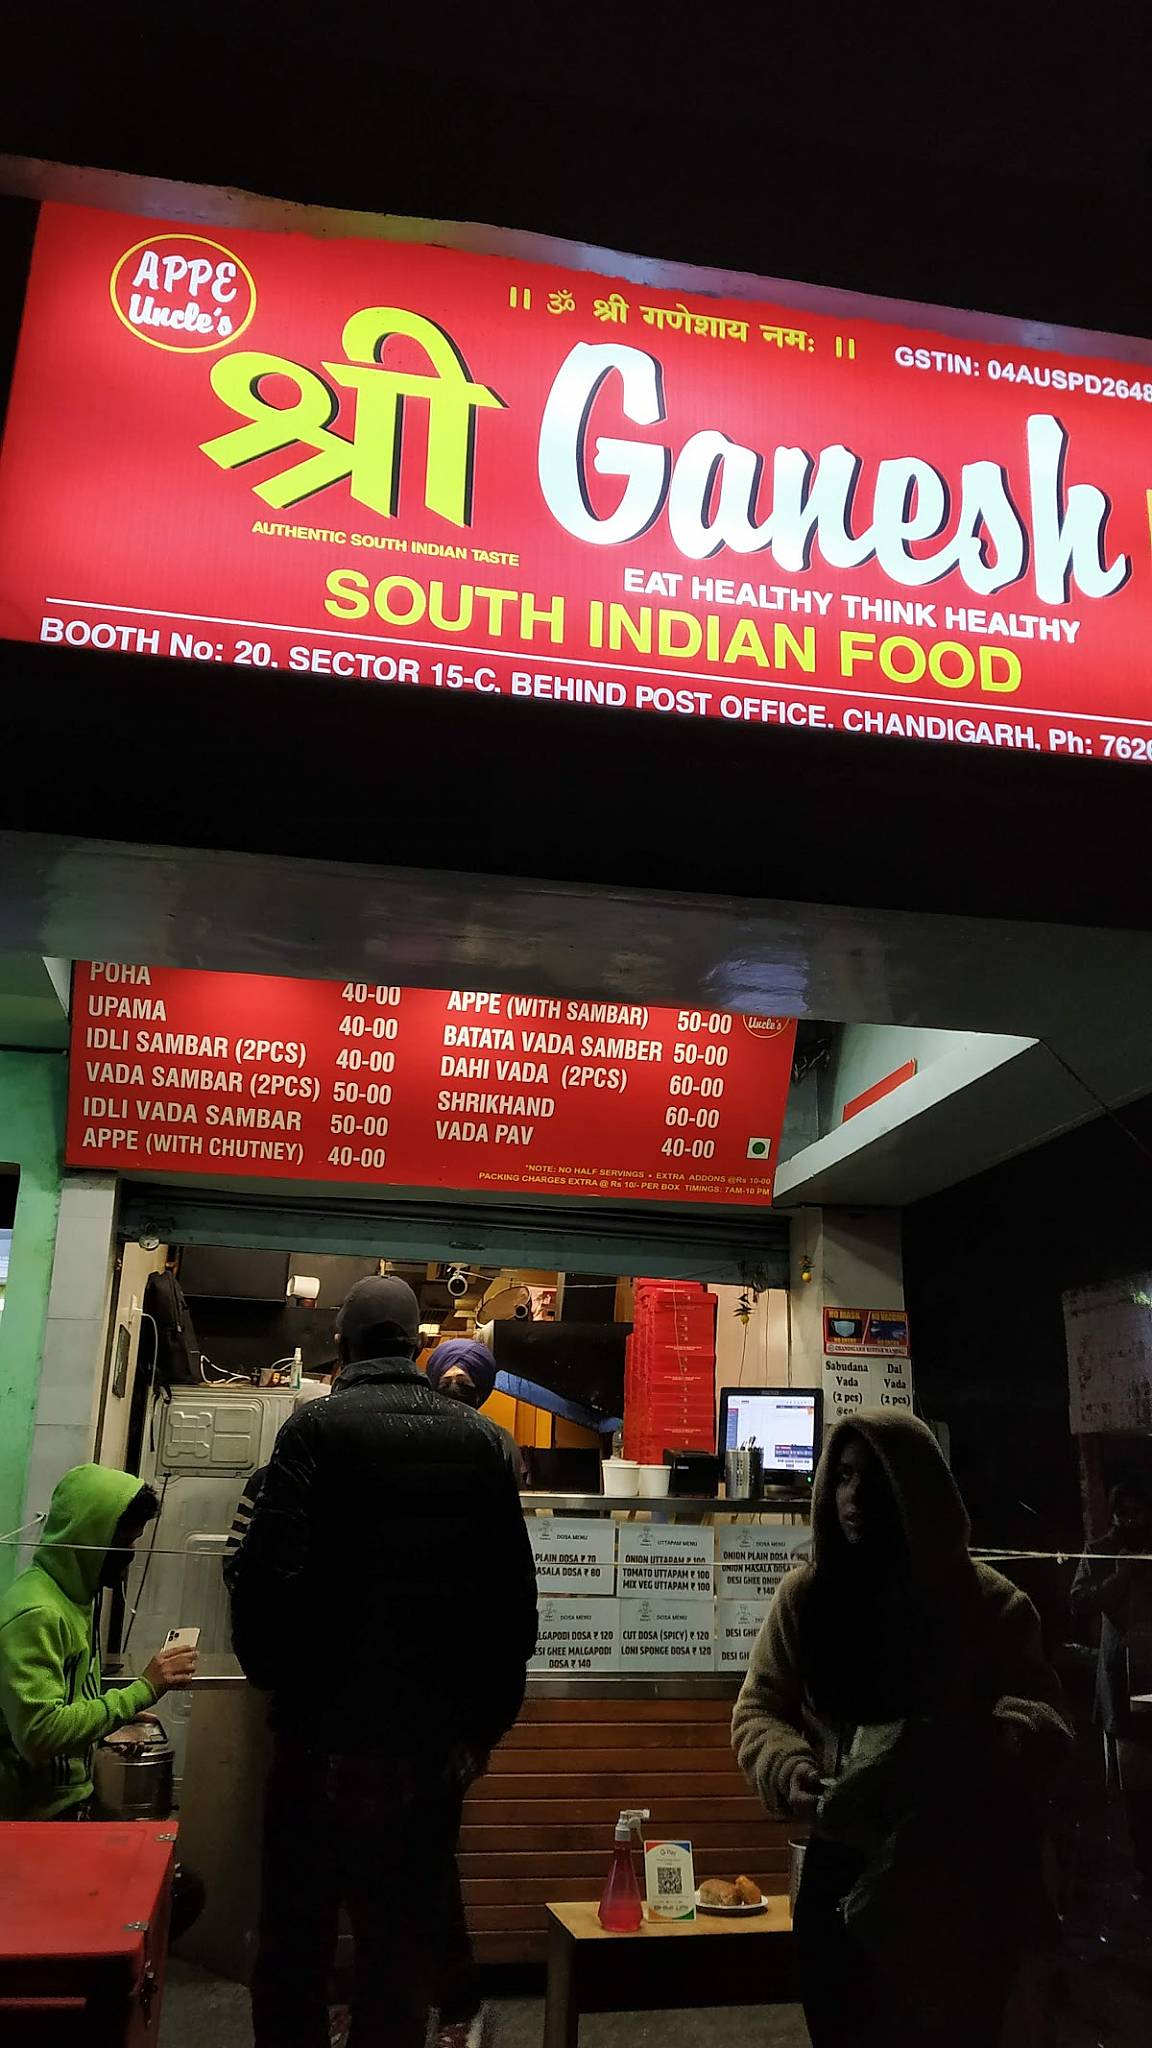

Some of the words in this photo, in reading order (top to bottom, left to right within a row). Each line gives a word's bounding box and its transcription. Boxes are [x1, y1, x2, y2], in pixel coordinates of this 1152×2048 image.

[132, 251, 237, 302] APPE
[128, 293, 233, 337] Uncle's
[593, 293, 629, 324] श्री
[639, 303, 749, 342] गणेशाय
[759, 324, 815, 353] नमः
[895, 346, 980, 377] GSTIN:
[198, 306, 510, 528] श्री
[538, 341, 1132, 604] Ganesh
[252, 521, 347, 545] AUTHENTIC
[350, 533, 408, 553] SOUTH
[411, 541, 467, 560] INDIAN
[471, 548, 519, 566] TASTE
[623, 567, 682, 596] EAT
[692, 577, 833, 617] HEALTHY
[841, 594, 936, 628] THINK
[945, 606, 1080, 644] HEALTHY
[324, 568, 564, 644] SOUTH
[589, 600, 815, 673] INDIAN
[840, 631, 1022, 693] FOOD
[40, 616, 159, 655] BOOTH
[169, 635, 224, 663] No:
[288, 645, 420, 684] SECTOR
[511, 671, 626, 707] BEHIND
[635, 684, 712, 716] POST
[1048, 728, 1093, 755] Ph:
[90, 961, 151, 985] POHA
[342, 982, 400, 1006] 40-00
[87, 995, 166, 1021] UPAMA
[447, 991, 501, 1014] APPE
[506, 995, 561, 1020] (WITH
[566, 1001, 649, 1030] SAMBAR)
[339, 1015, 398, 1040] 40-00
[677, 1011, 732, 1035] 50-00
[748, 1016, 782, 1030] Uncle's
[86, 1027, 128, 1051] IDLI
[135, 1030, 228, 1059] SAMBAR
[235, 1038, 306, 1068] (2PCS)
[443, 1025, 515, 1051] BATATA
[521, 1031, 575, 1056] VADA
[580, 1036, 663, 1062] SAMBER
[673, 1043, 729, 1067] 50-00
[336, 1048, 394, 1073] 40-00
[86, 1062, 144, 1085] VADA
[151, 1066, 242, 1094] SAMBAR
[250, 1073, 320, 1102] (2PCS)
[440, 1056, 489, 1079] DAHI
[496, 1060, 549, 1084] VADA
[561, 1064, 628, 1093] (2PCS)
[333, 1081, 391, 1105] 50-00
[669, 1075, 724, 1098] 60-00
[83, 1097, 128, 1119] IDLI
[136, 1101, 198, 1124] VADA
[205, 1105, 302, 1132] SAMBAR
[437, 1091, 555, 1118] SHRIKHAND
[330, 1114, 388, 1137] 50-00
[665, 1106, 720, 1129] 60-00
[435, 1120, 489, 1143] VADA
[495, 1124, 534, 1146] PAV
[82, 1127, 138, 1150] APPE
[146, 1132, 203, 1156] (WITH
[209, 1137, 304, 1165] CHUTNEY)
[328, 1146, 385, 1168] 40-00
[661, 1138, 715, 1160] 40-00
[479, 1172, 520, 1181] PACKING
[521, 1175, 566, 1184] CHARGES
[568, 1178, 598, 1186] EXTRA
[599, 1180, 609, 1188] @
[611, 1180, 622, 1188] Rs
[641, 1182, 659, 1190] PER
[661, 1183, 680, 1191] BOX
[685, 1184, 722, 1193] TIMINGS:
[558, 1166, 572, 1174] NO
[599, 1169, 644, 1178] SERVINGS
[656, 1172, 685, 1180] EXTRA
[688, 1174, 726, 1183] ADDONS
[825, 1361, 869, 1373] Sabudana
[887, 1364, 902, 1374] Dal
[836, 1376, 859, 1387] Vada
[884, 1379, 906, 1389] Vada
[833, 1391, 842, 1404] (2
[844, 1392, 862, 1405] pcs)
[880, 1393, 890, 1406] (2
[892, 1394, 911, 1407] pcs)
[535, 1553, 557, 1562] PLAIN
[560, 1554, 578, 1562] DOSA
[625, 1555, 648, 1563] ONION
[723, 1551, 746, 1560] ONION
[747, 1552, 768, 1560] PLAIN
[536, 1567, 560, 1576] ASALA
[562, 1568, 582, 1576] DOSA
[623, 1568, 653, 1577] TOMATO
[654, 1569, 689, 1578] UTTAPAM
[697, 1570, 710, 1579] 100
[744, 1564, 772, 1573] MASALA
[623, 1579, 637, 1589] MIX
[639, 1580, 653, 1589] VEG
[654, 1581, 689, 1590] UTTAPAM
[697, 1582, 711, 1591] 100
[727, 1576, 742, 1584] DESI
[743, 1576, 760, 1585] GHEE
[572, 1631, 591, 1640] DOSA
[600, 1631, 613, 1640] 120
[622, 1631, 636, 1640] CUT
[638, 1631, 658, 1640] DOSA
[660, 1630, 688, 1642] (SPICY)
[696, 1631, 709, 1640] 120
[726, 1628, 741, 1637] DESI
[547, 1647, 567, 1656] GHEE
[568, 1646, 612, 1656] MALGAPODI
[621, 1647, 638, 1655] LONI
[639, 1647, 669, 1656] SPONGE
[671, 1647, 690, 1656] DOSA
[698, 1647, 712, 1656] 120
[722, 1652, 737, 1660] DESI
[549, 1659, 568, 1668] DOSA
[578, 1659, 591, 1668] 140
